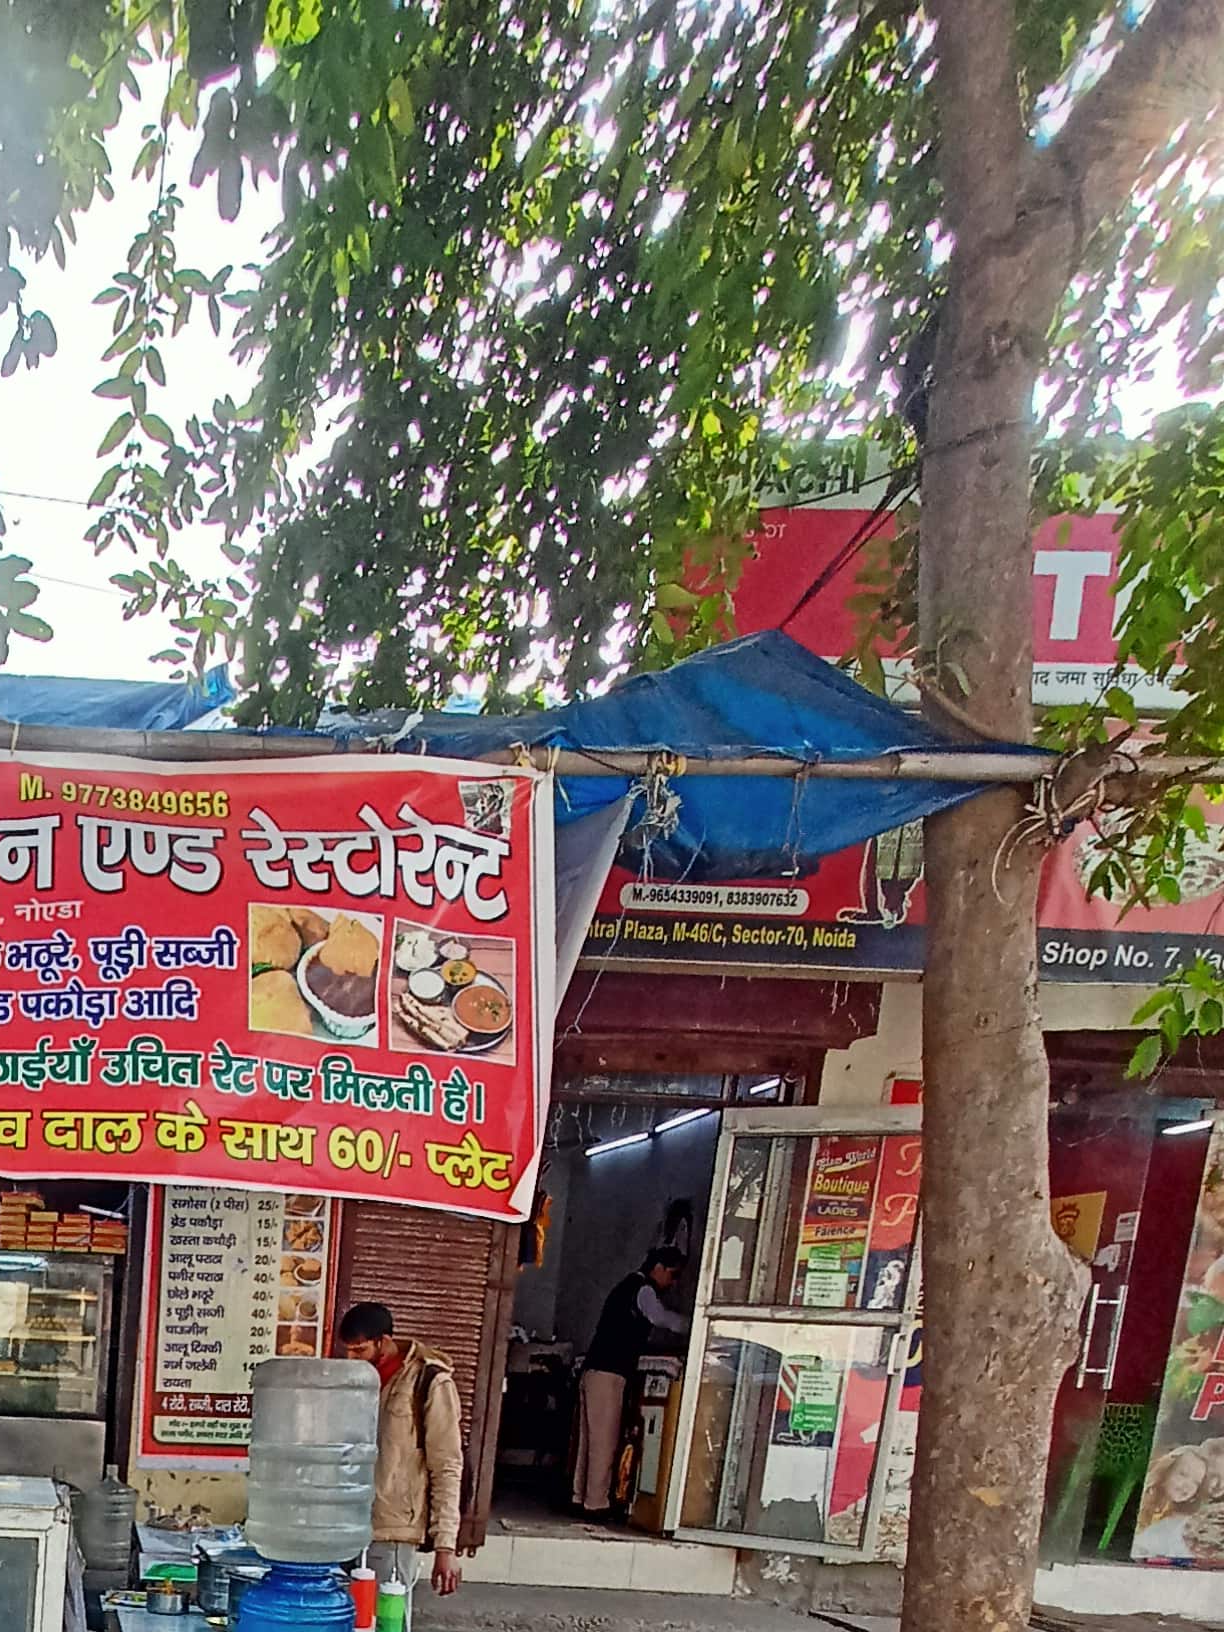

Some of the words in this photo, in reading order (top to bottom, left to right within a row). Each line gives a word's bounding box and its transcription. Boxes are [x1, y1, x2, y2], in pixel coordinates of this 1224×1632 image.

[19, 773, 53, 801] M.
[62, 781, 229, 817] 9773849656
[77, 815, 225, 893] एण्ड
[242, 801, 510, 920] रेस्टोरेन्ट
[14, 898, 83, 923] नोएडा
[153, 926, 239, 970] सब्जी
[623, 919, 668, 945] Plaza,
[731, 925, 807, 950] Sector-70,
[812, 926, 856, 949] Noida
[1041, 941, 1108, 970] Shop
[1114, 945, 1154, 969] No.
[124, 979, 198, 1021] आदि
[101, 1036, 202, 1087] उचित
[210, 1041, 258, 1096] रेट
[264, 1061, 314, 1102] पर
[321, 1056, 433, 1115] मिलती
[42, 1111, 147, 1153] दाल
[153, 1100, 209, 1152] के
[220, 1120, 316, 1165] साथ
[328, 1125, 412, 1179] 60/-
[813, 1174, 870, 1198] Boutique
